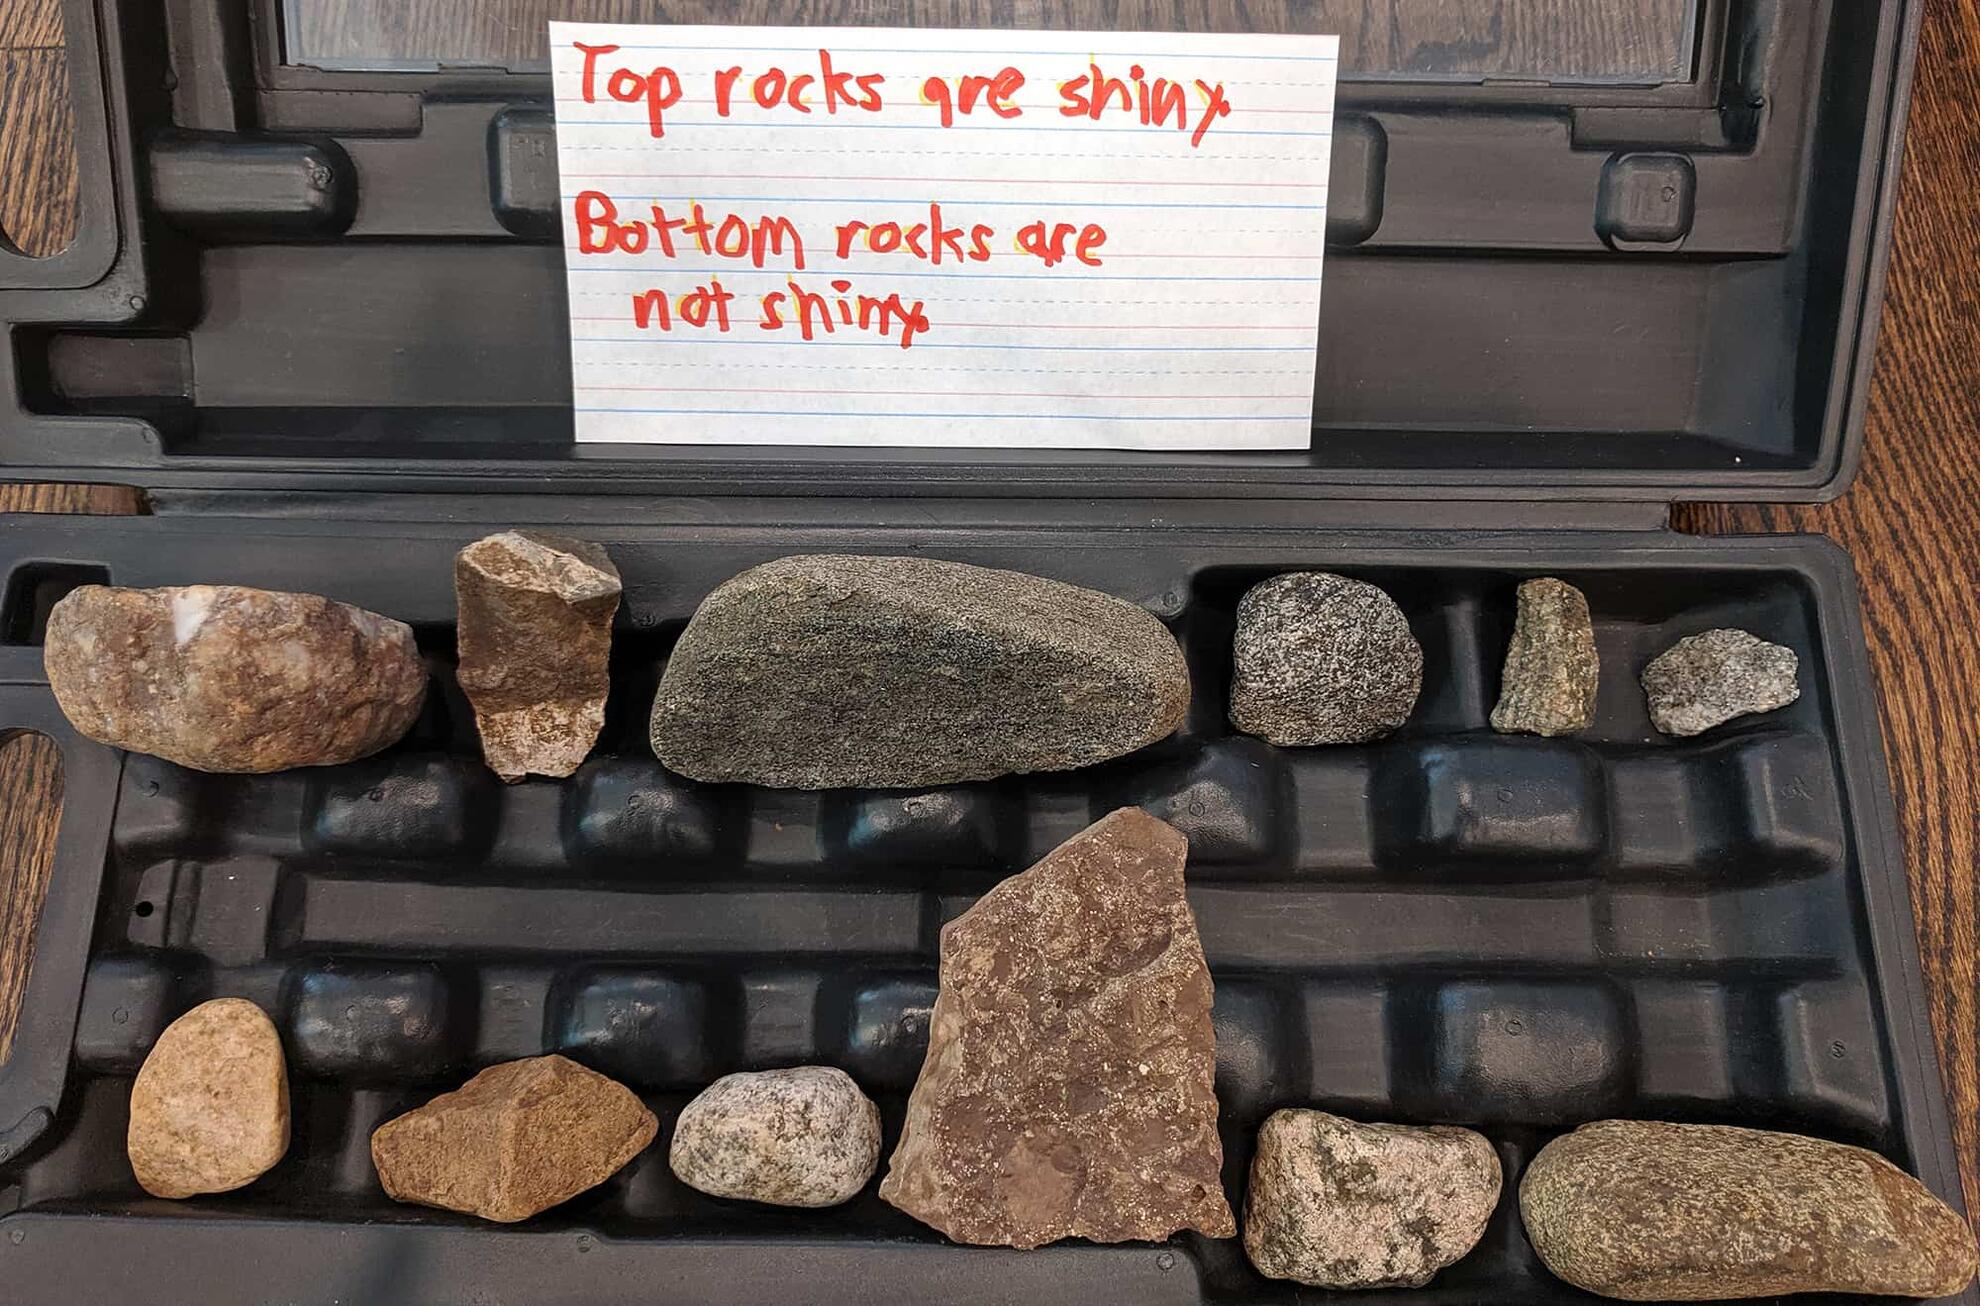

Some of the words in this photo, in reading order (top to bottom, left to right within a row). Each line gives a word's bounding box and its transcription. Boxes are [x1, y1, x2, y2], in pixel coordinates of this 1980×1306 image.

[573, 42, 682, 138] Top
[714, 49, 884, 116] rocks
[920, 67, 1026, 128] are
[1058, 59, 1231, 147] shiny.
[574, 190, 805, 270] Bottom
[836, 201, 993, 265] rocks
[1015, 220, 1107, 268] are
[632, 278, 734, 332] not
[758, 279, 930, 349] shiny.
